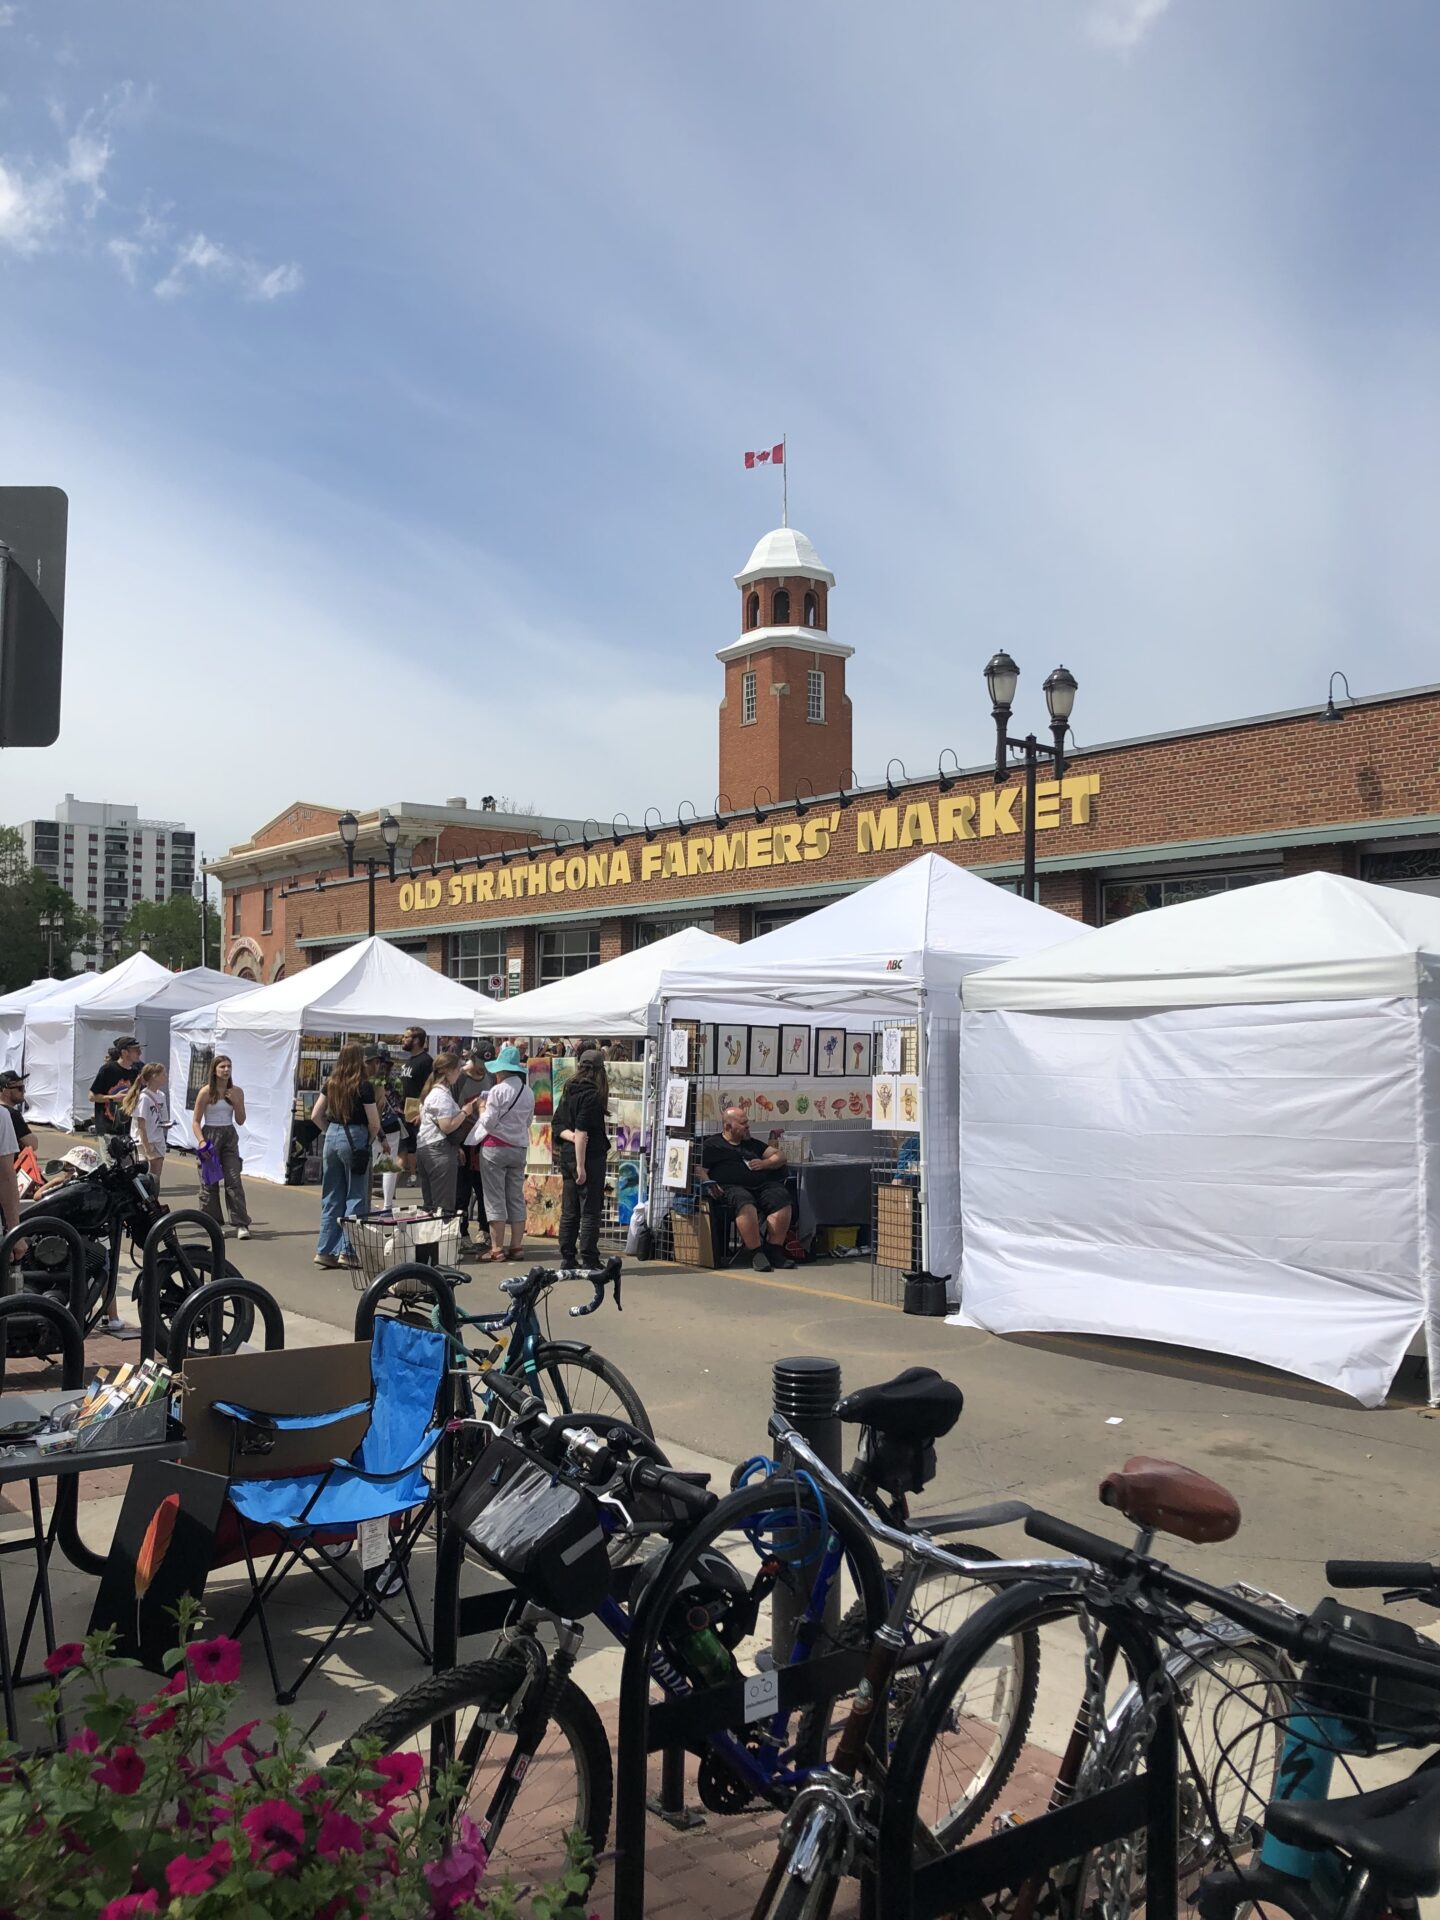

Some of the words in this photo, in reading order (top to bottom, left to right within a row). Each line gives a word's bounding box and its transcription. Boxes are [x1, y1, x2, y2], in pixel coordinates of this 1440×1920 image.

[399, 879, 442, 912] OLD
[448, 849, 631, 906] STRATHCONA
[641, 810, 842, 881] FARMERS'
[857, 773, 1100, 853] MARKET
[886, 959, 903, 970] ABC
